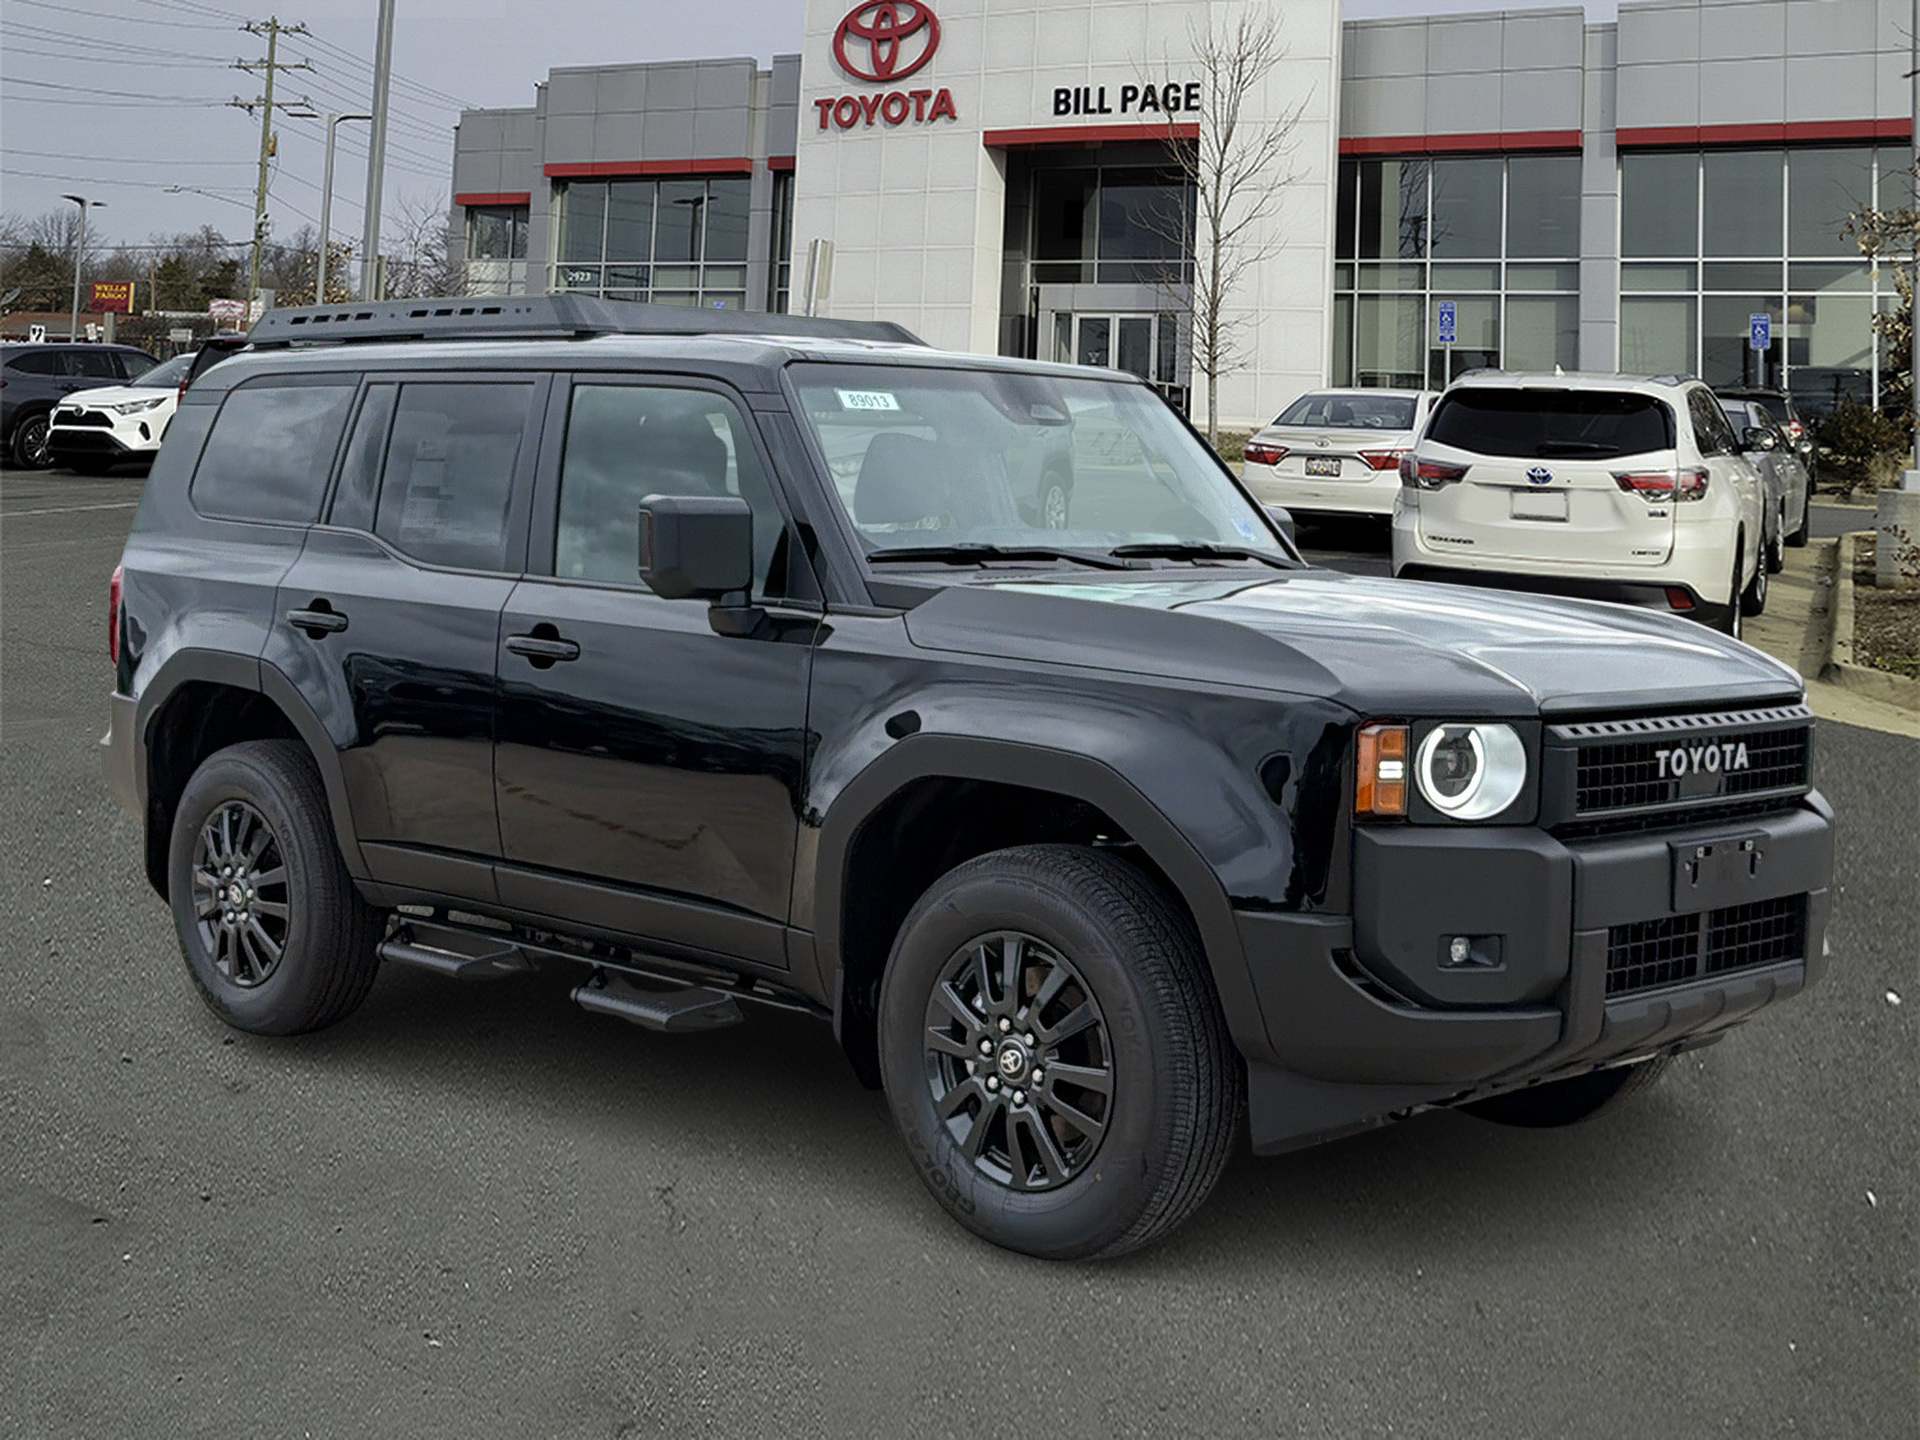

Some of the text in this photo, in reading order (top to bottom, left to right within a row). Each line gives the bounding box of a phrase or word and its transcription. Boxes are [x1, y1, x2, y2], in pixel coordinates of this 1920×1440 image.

[814, 87, 958, 130] TOYOTA
[1053, 82, 1200, 116] BILL PAGE
[848, 394, 890, 409] 89013
[1655, 742, 1749, 778] TOYOTA
